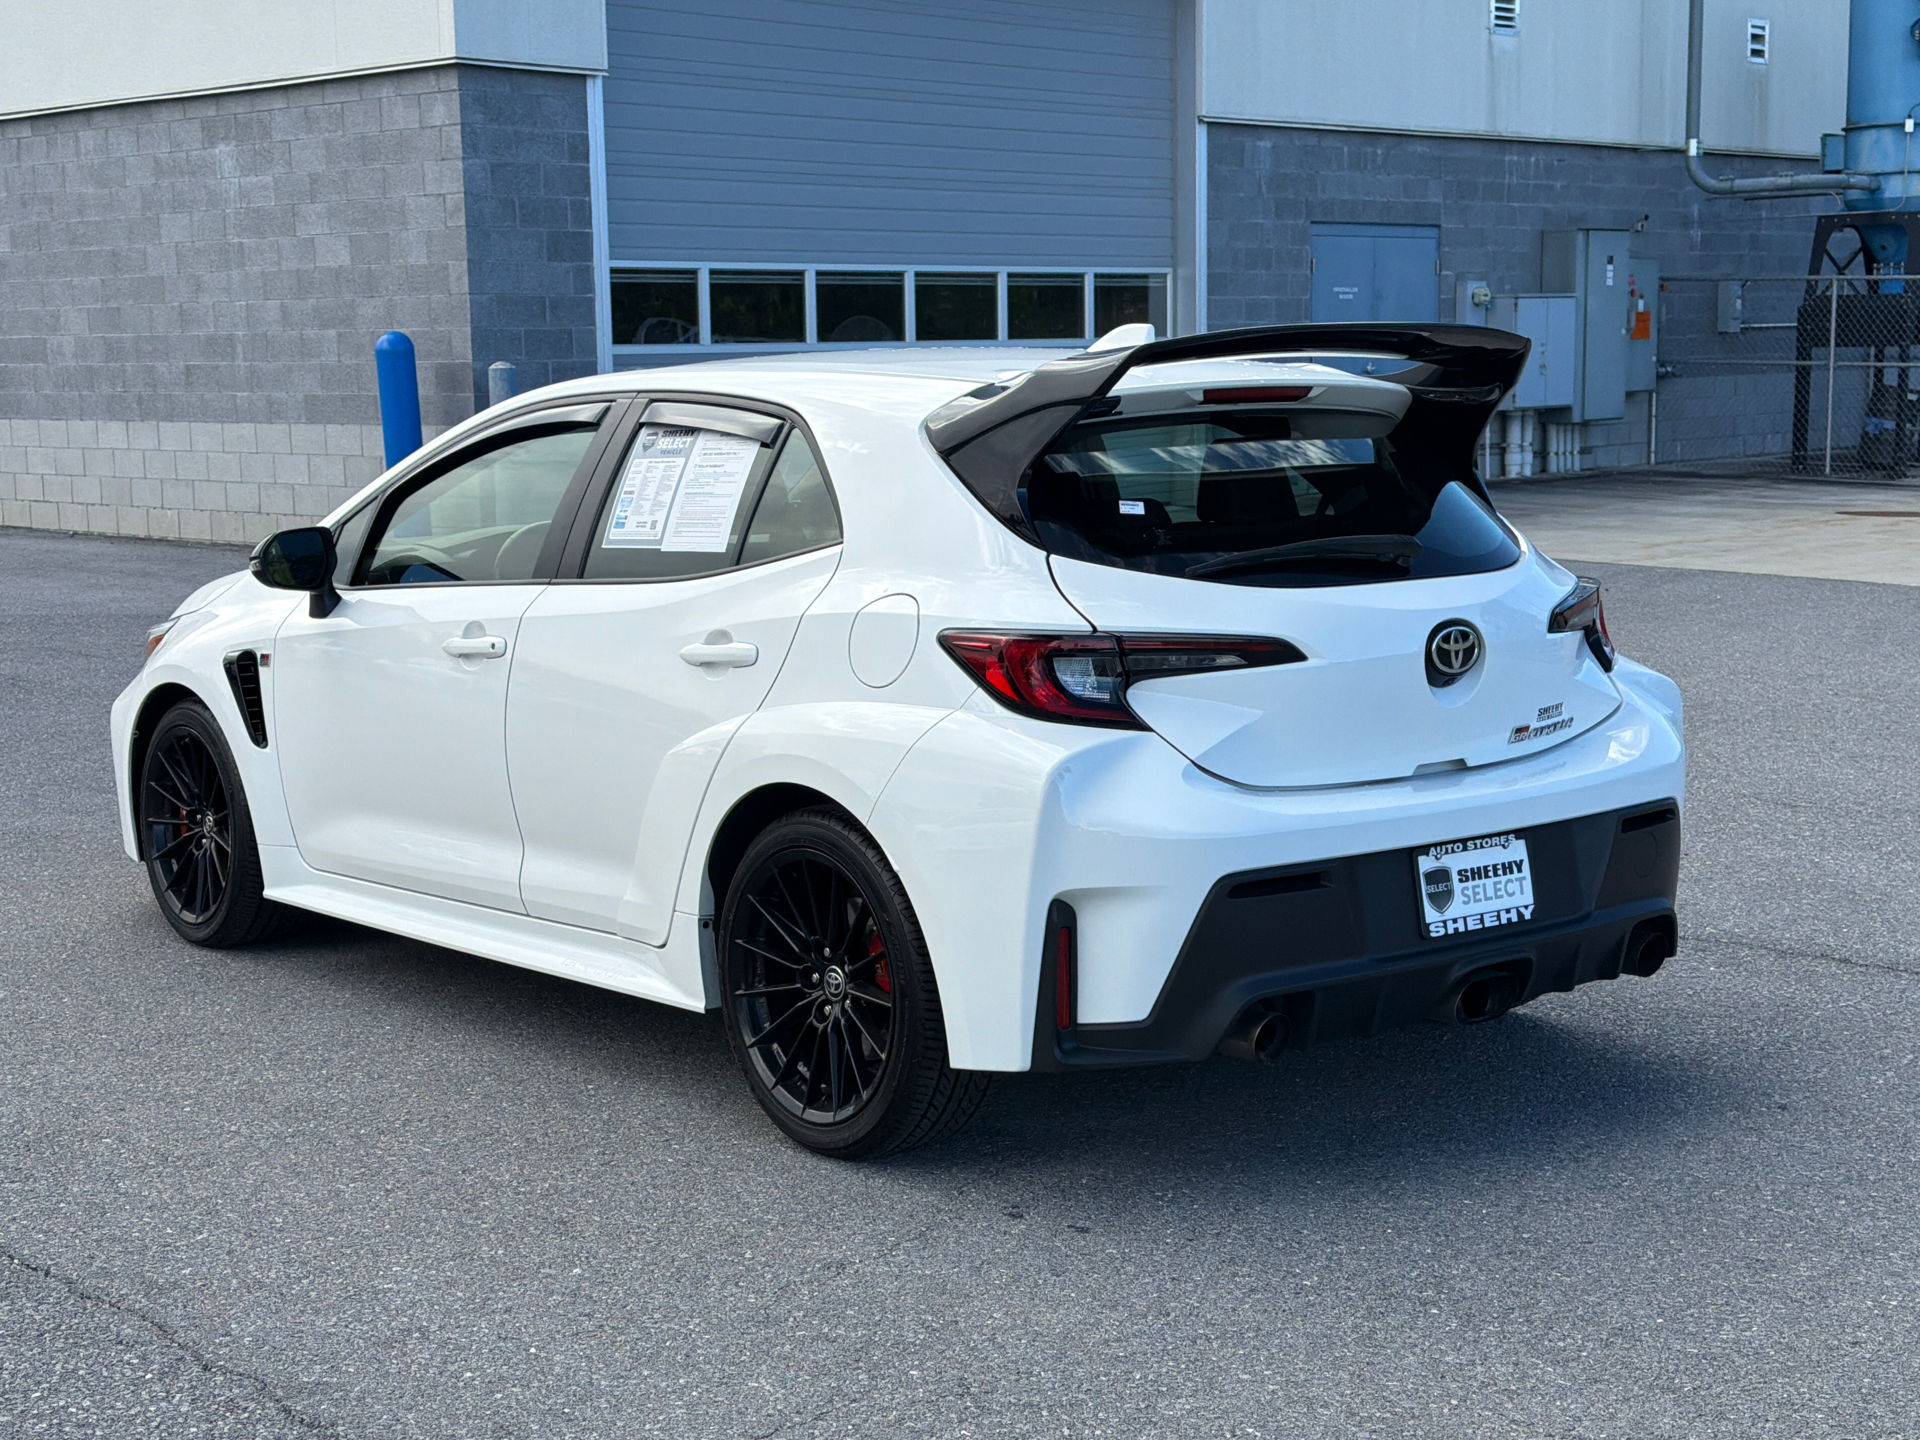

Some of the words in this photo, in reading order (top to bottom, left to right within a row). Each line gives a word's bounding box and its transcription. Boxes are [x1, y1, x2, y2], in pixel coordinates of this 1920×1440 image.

[661, 428, 697, 437] SHEEHY
[656, 437, 693, 449] SELECT
[1537, 702, 1564, 717] SHEEHY
[1428, 842, 1463, 857] AUTO
[1466, 834, 1516, 850] STORES
[1457, 859, 1525, 884] SHEEHY
[1426, 882, 1452, 894] SELECT
[1460, 876, 1527, 905] SELECT
[1428, 905, 1535, 938] SHEEHY
